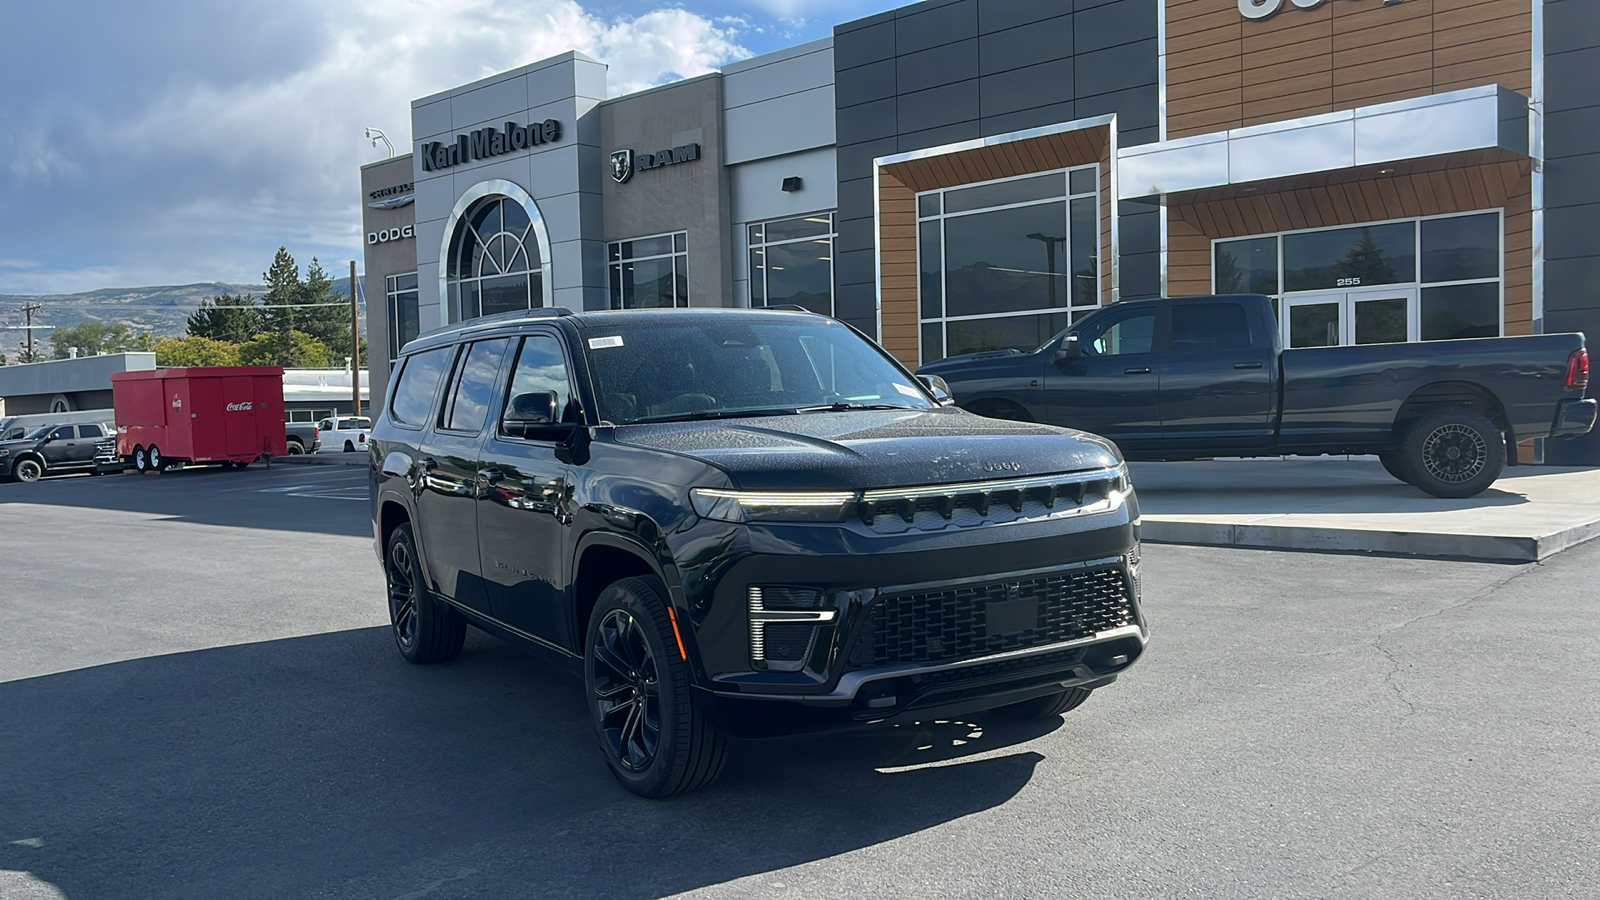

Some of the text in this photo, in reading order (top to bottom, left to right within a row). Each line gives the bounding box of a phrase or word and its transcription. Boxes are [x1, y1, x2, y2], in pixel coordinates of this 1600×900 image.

[421, 118, 562, 171] Karl Malone
[635, 143, 700, 171] RAM
[368, 224, 417, 245] DODG
[1336, 277, 1361, 287] 255
[982, 461, 1020, 472] Jeep
